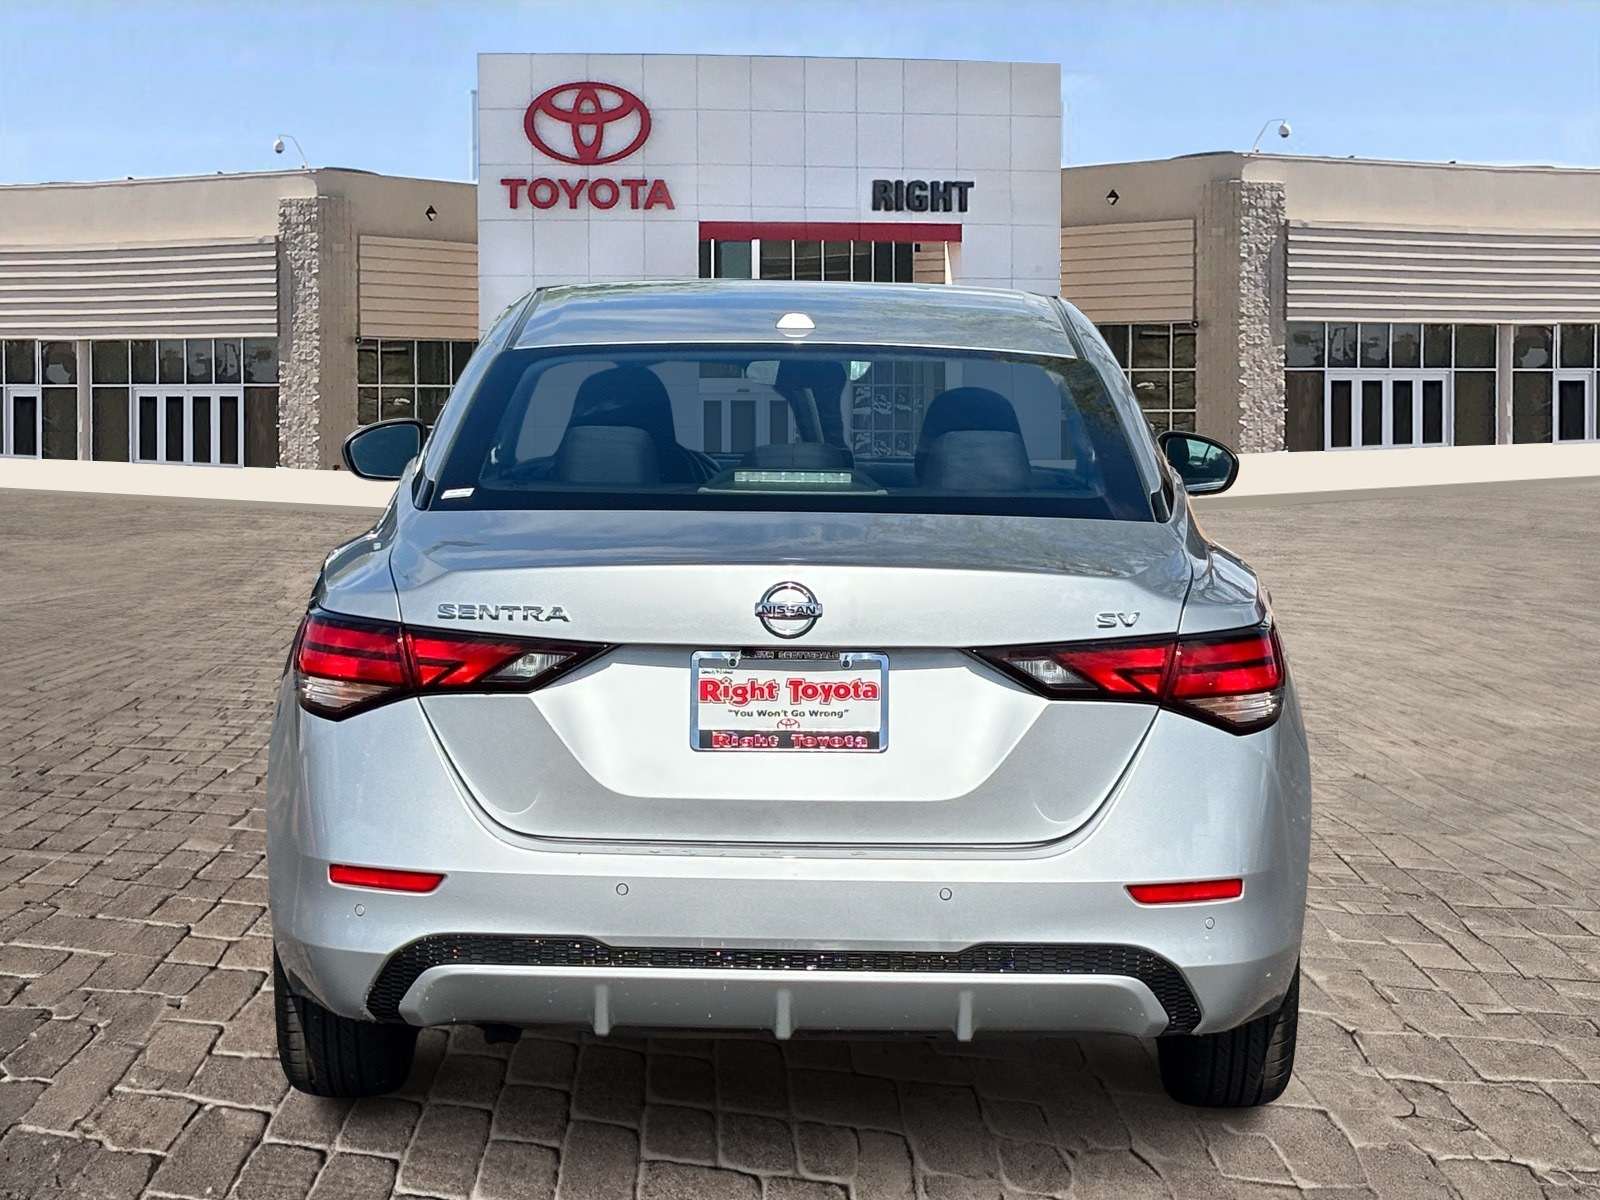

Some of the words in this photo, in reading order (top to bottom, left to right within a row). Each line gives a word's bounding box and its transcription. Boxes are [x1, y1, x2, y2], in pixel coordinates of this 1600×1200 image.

[500, 178, 675, 210] TOYOTA
[871, 179, 975, 213] RIGHT
[437, 603, 571, 623] SENTRA
[761, 604, 816, 615] NISSAN
[1096, 611, 1140, 629] SV
[699, 677, 780, 707] Right
[786, 677, 880, 706] Toyota
[791, 708, 806, 718] Go
[712, 731, 779, 748] Right
[790, 732, 868, 749] Toyota
